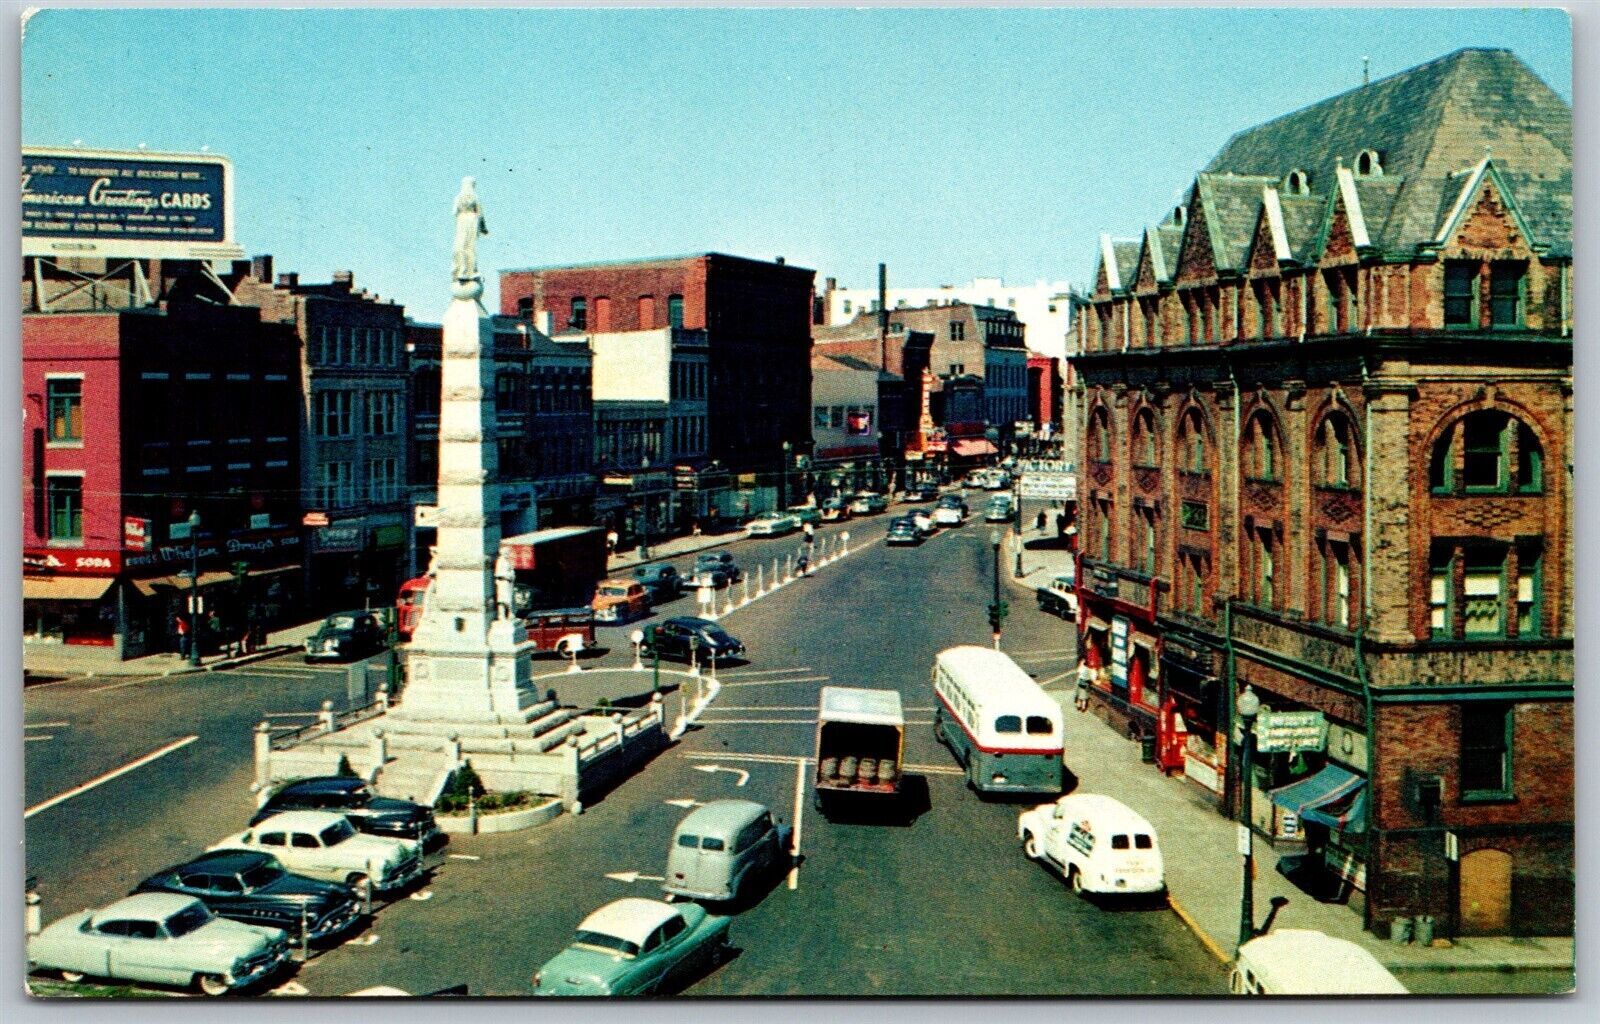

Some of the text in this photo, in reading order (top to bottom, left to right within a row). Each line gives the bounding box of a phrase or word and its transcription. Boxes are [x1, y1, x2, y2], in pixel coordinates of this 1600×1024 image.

[89, 176, 159, 214] Greetings
[160, 192, 212, 210] CARDS
[77, 557, 112, 568] SODA
